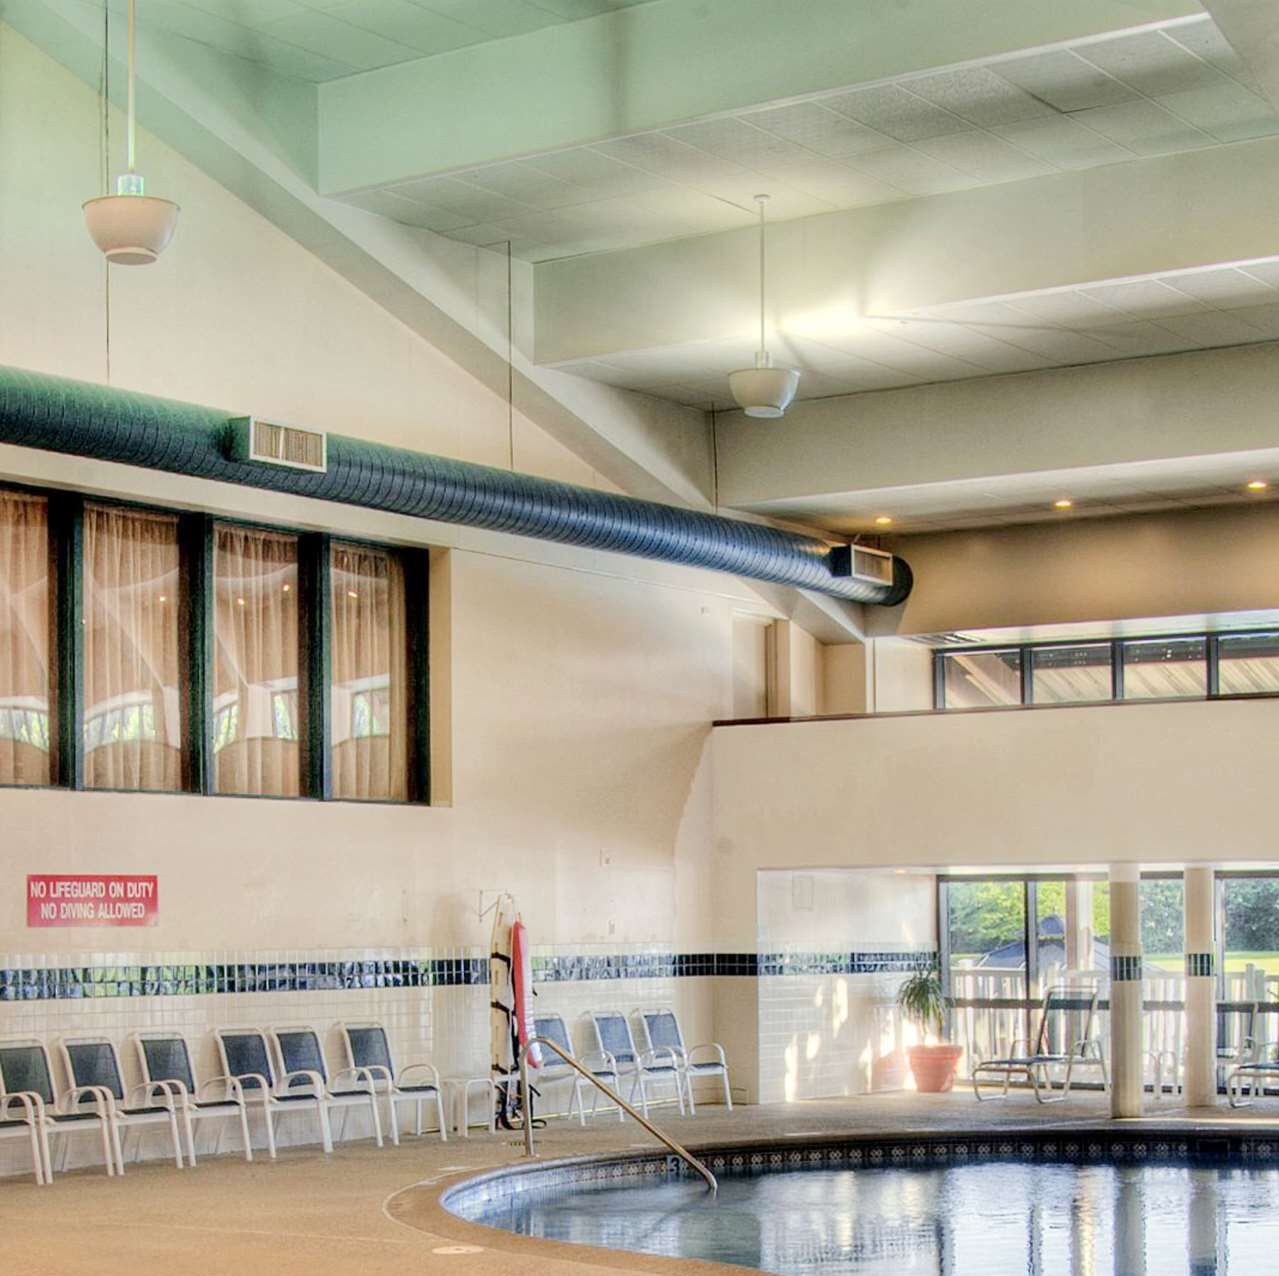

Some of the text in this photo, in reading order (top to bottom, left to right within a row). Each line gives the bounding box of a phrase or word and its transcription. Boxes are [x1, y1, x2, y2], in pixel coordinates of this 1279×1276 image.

[30, 881, 154, 898] NO LIFEGUARD ON DUTY
[41, 902, 145, 919] NO DIVING ALLOWED
